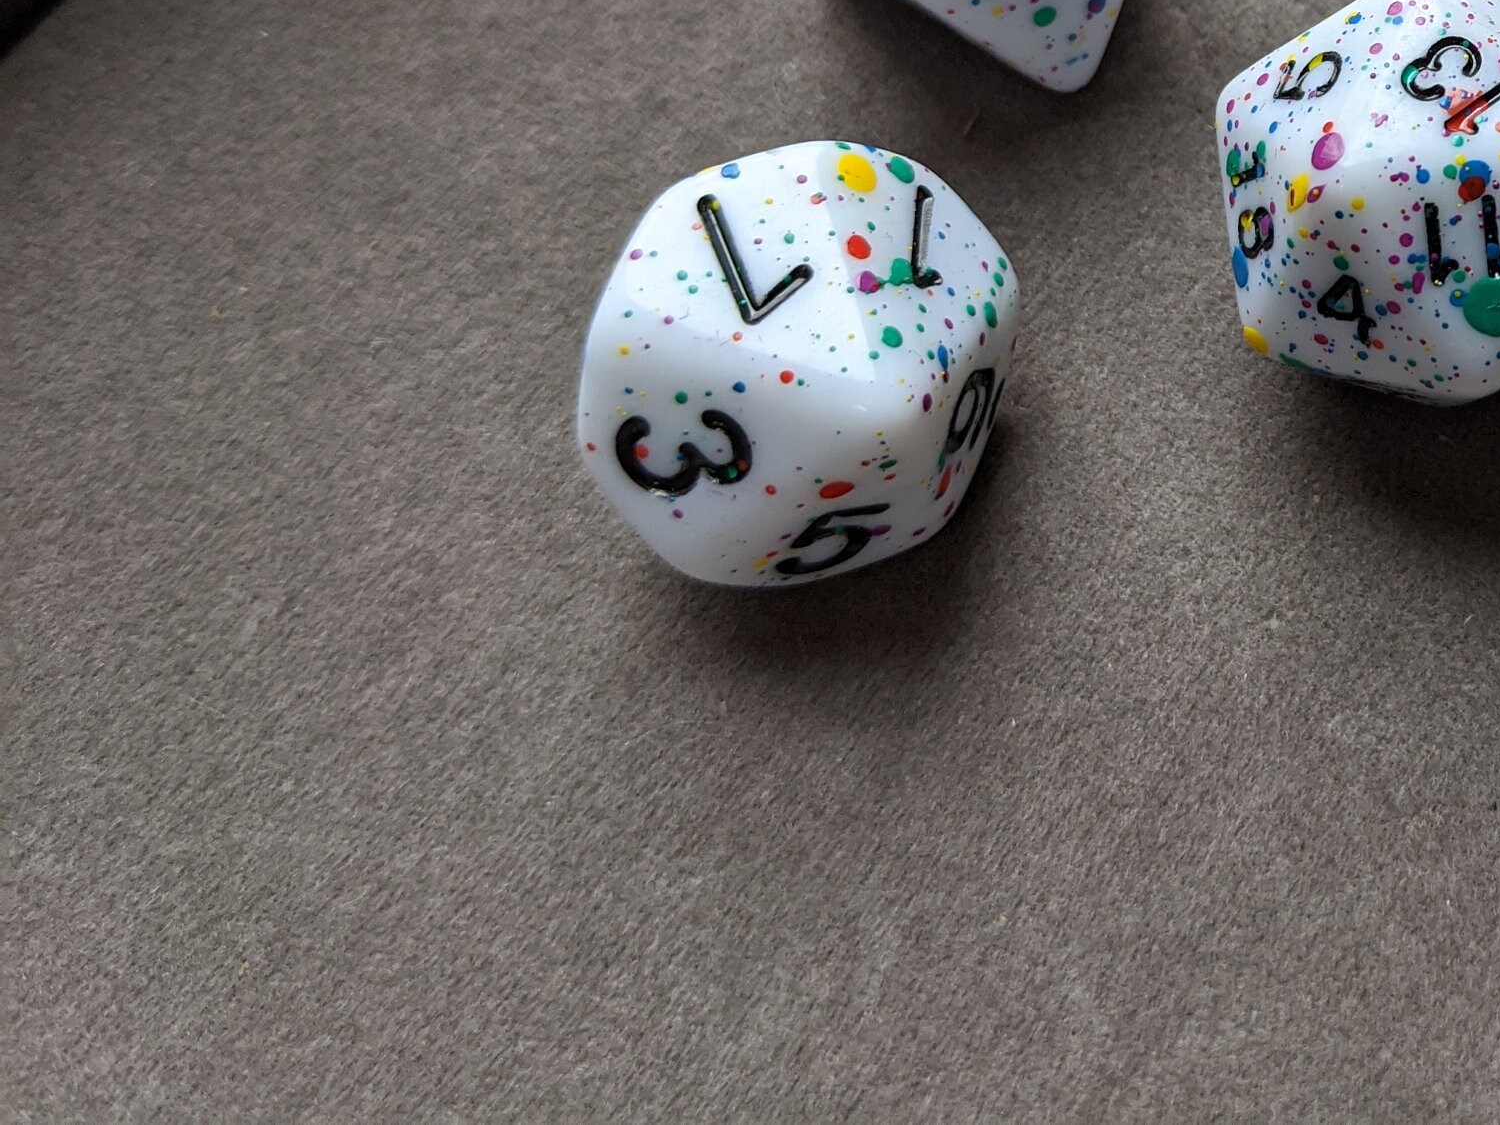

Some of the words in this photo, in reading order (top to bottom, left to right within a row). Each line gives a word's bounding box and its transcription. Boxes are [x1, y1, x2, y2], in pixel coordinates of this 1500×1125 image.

[1273, 50, 1343, 101] 5
[697, 193, 814, 325] 7
[912, 185, 942, 288] 1
[1317, 275, 1378, 348] 4
[615, 409, 753, 498] 3
[775, 503, 890, 574] 5
